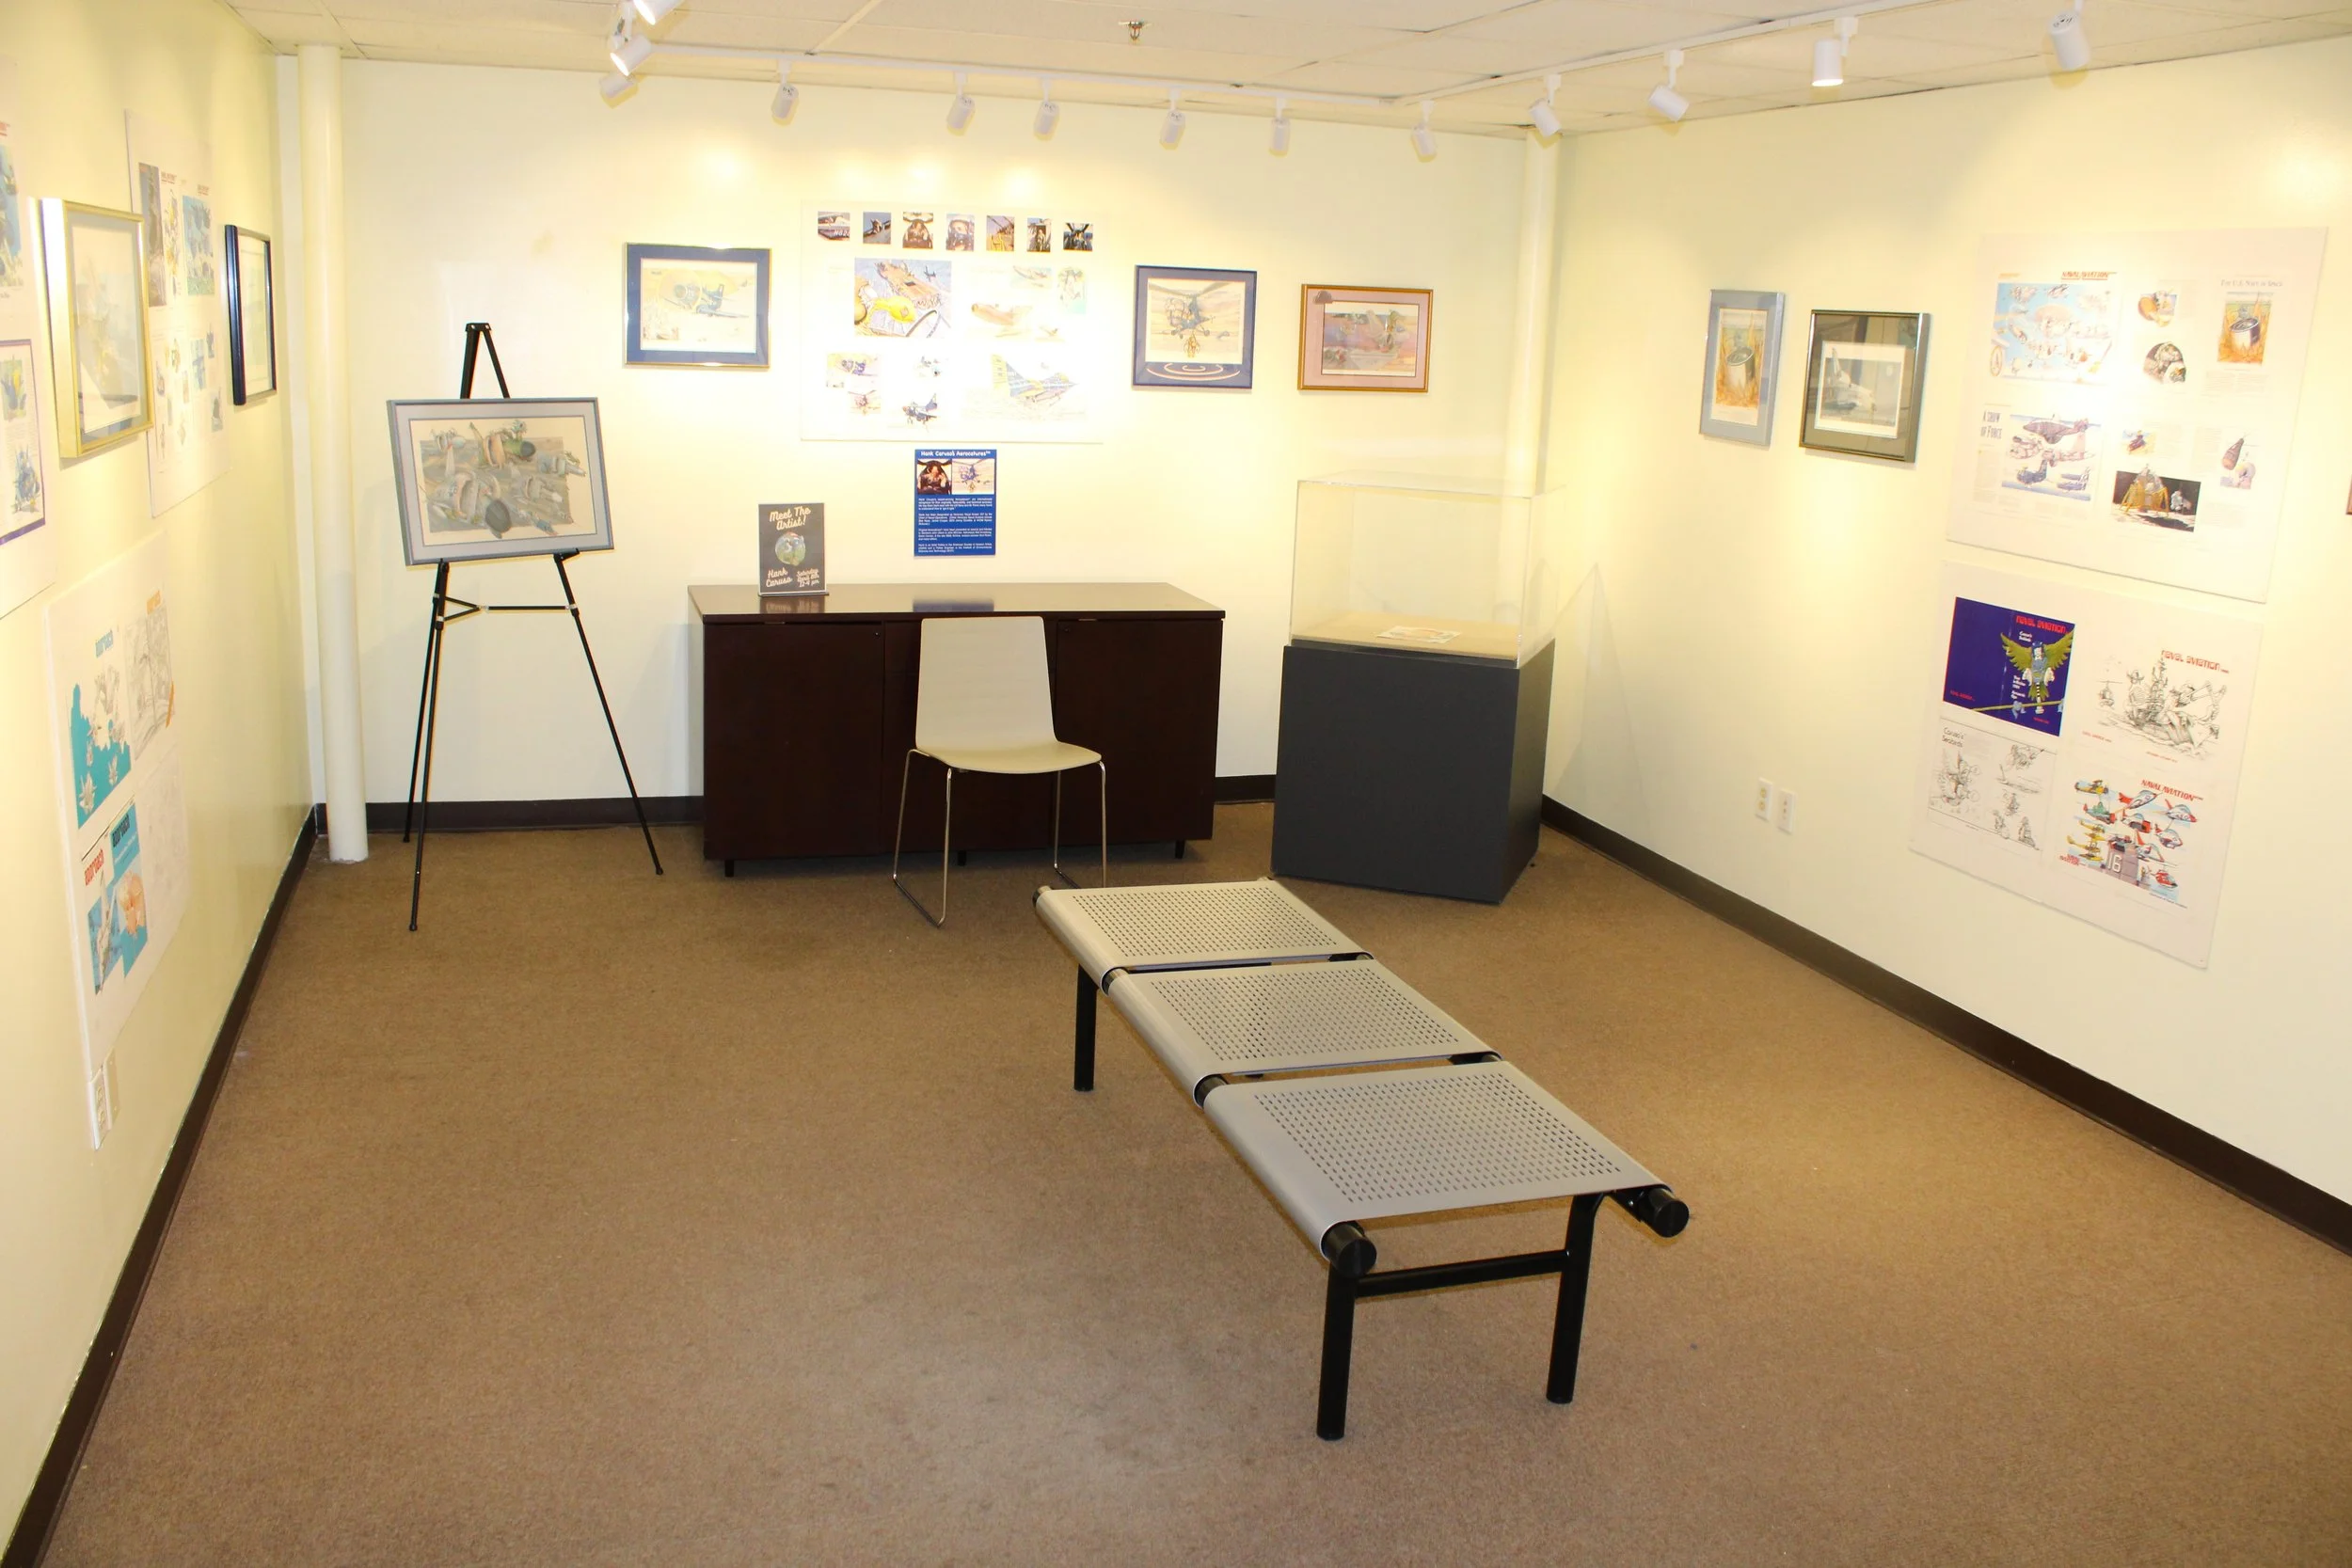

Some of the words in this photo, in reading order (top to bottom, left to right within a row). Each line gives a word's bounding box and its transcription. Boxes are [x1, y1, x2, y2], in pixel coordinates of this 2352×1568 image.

[2081, 271, 2108, 279] AVIATION
[770, 508, 792, 522] Meet
[794, 506, 811, 516] The
[776, 515, 806, 531] Artist!
[768, 567, 788, 578] Hank
[766, 577, 793, 587] Caruso
[2141, 779, 2161, 791] NAVAL
[2162, 785, 2194, 801] AVIATION
[84, 847, 104, 886] approach
[2107, 853, 2123, 874] 16
